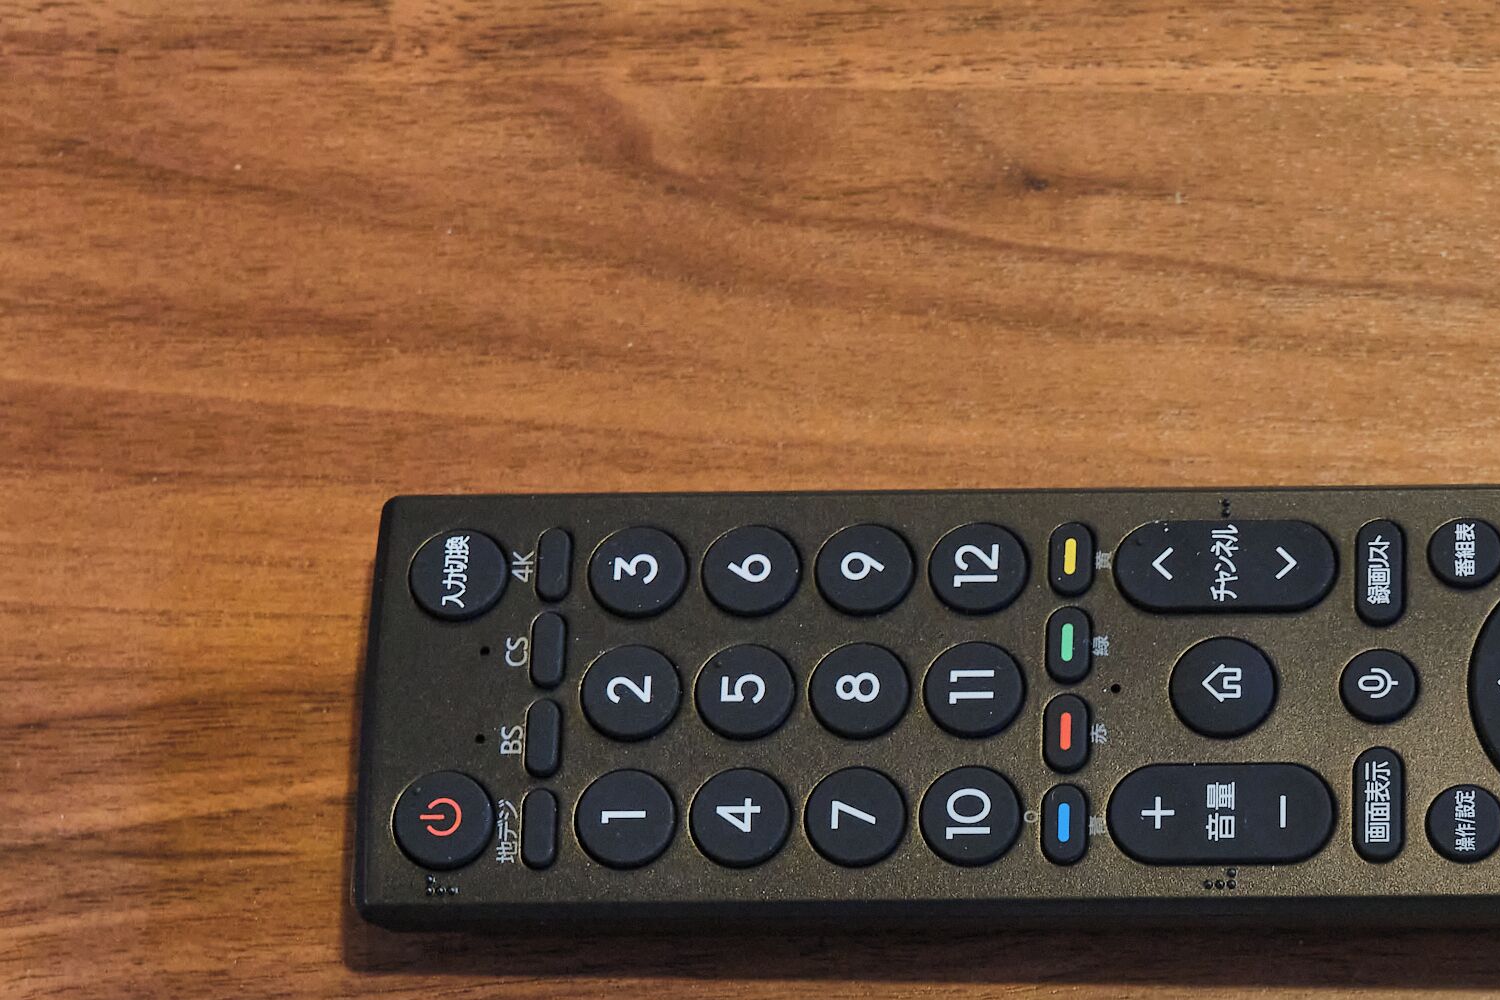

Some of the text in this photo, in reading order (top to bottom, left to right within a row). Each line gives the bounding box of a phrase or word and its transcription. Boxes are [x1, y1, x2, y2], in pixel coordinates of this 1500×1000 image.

[512, 551, 534, 582] 4K
[840, 551, 885, 582] 9
[953, 543, 1000, 589] 12
[1096, 550, 1111, 570] 黄
[1209, 525, 1240, 602] チャンネル
[1455, 524, 1476, 577] 番組表
[441, 535, 470, 608] 入力切換
[613, 553, 659, 585] 3
[727, 553, 772, 583] 6
[1367, 535, 1391, 604] 録画リスト
[505, 637, 528, 666] CS
[1092, 636, 1109, 656] 緑
[606, 675, 652, 705] 2
[720, 673, 766, 704] 5
[835, 671, 881, 703] 8
[949, 668, 995, 705] 11
[500, 725, 522, 754] BS
[1092, 724, 1107, 743] 赤
[601, 809, 647, 825] 1
[715, 797, 761, 833] 4
[831, 800, 877, 830] 7
[945, 788, 992, 840] 10
[1206, 781, 1235, 842] 音量
[1364, 761, 1392, 843] 画面表示
[496, 799, 516, 863] 地デジ
[1455, 790, 1476, 852] 操作/設定
